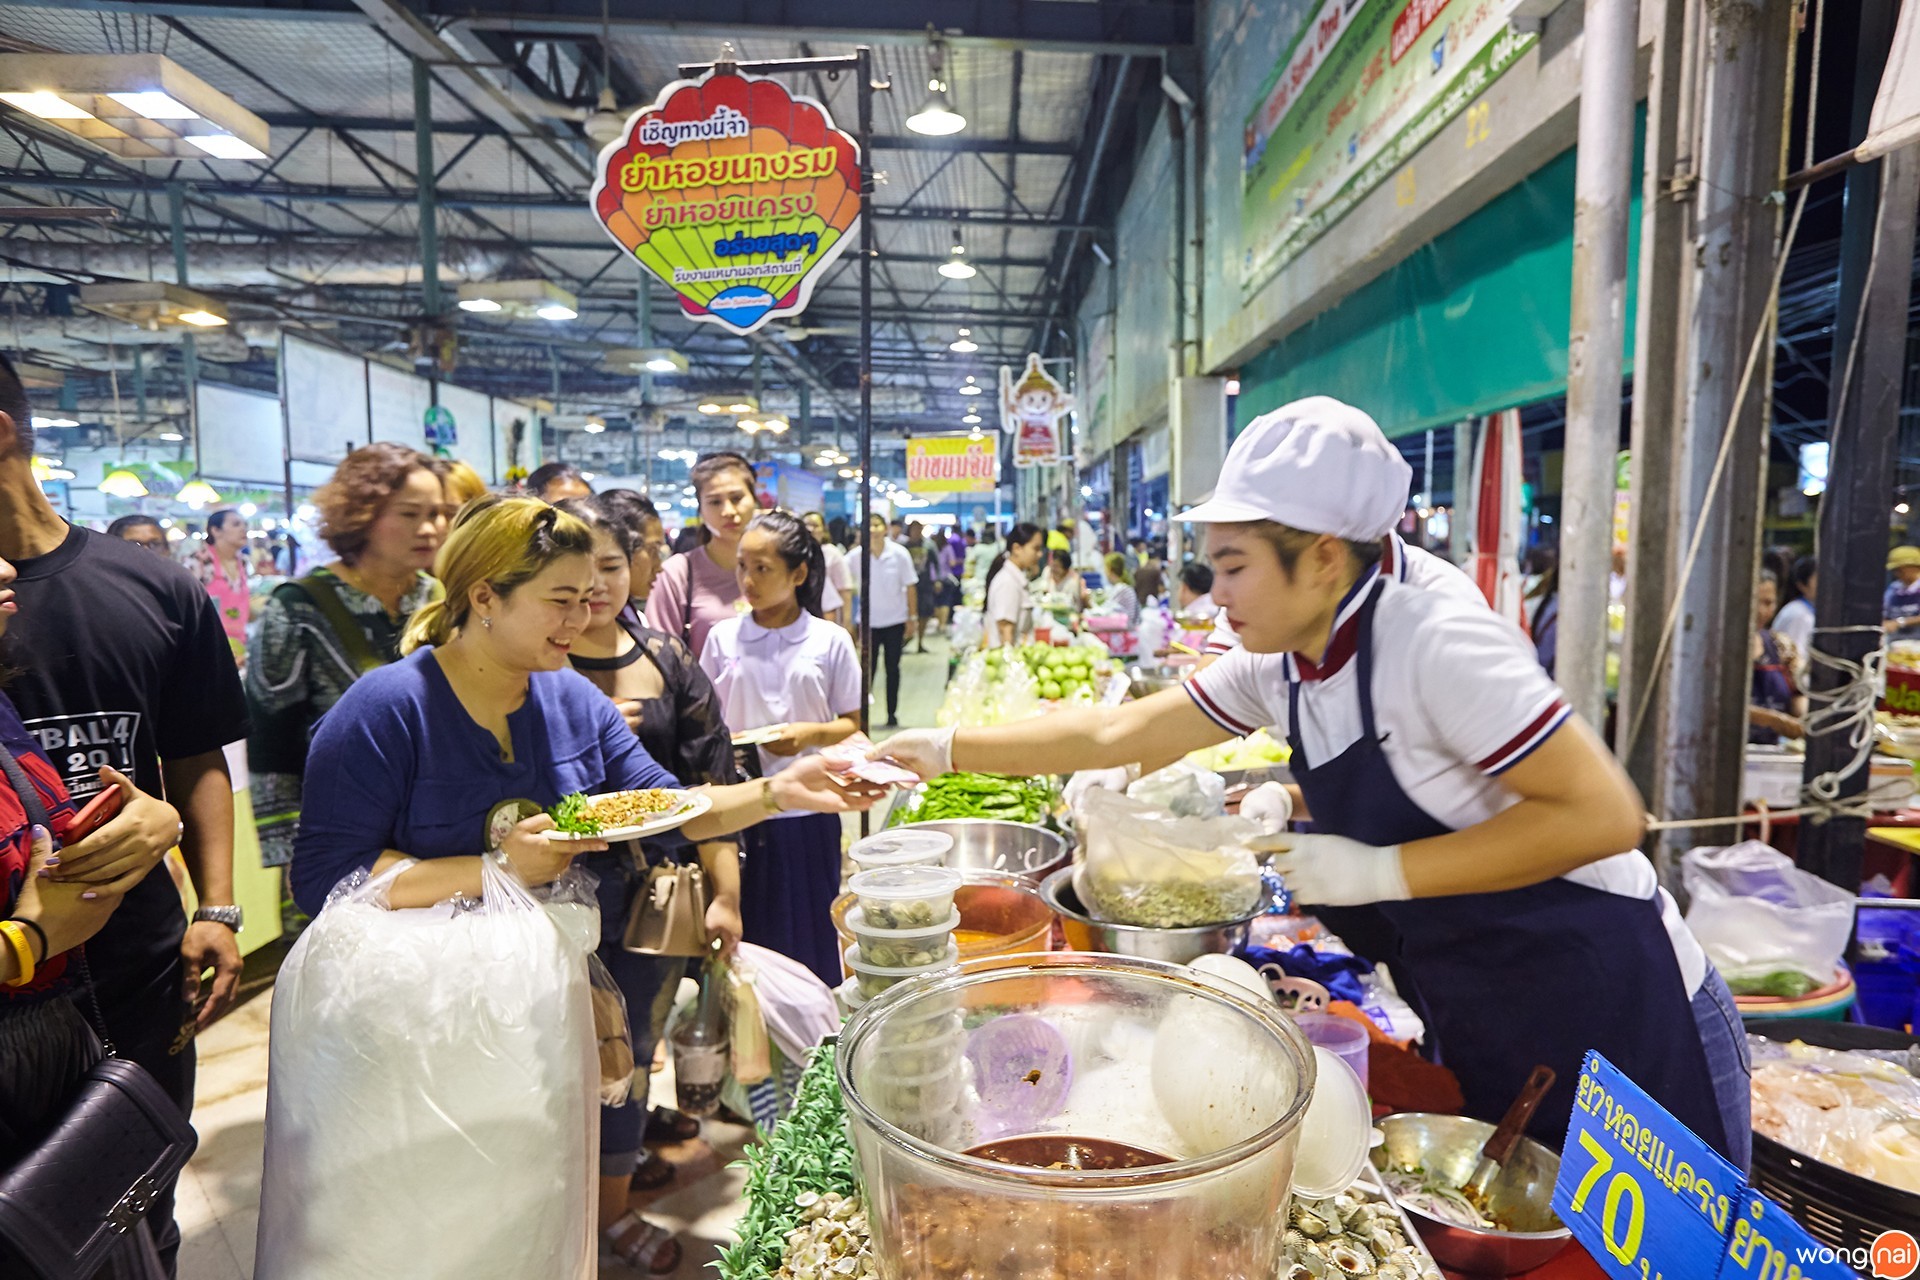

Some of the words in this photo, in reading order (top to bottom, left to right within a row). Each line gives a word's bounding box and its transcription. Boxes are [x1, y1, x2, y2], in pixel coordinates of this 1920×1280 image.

[641, 108, 747, 143] เชิญทางนี้จ้า
[623, 149, 835, 190] ยำหอยนางรม
[645, 194, 814, 226] ยำหอยแครง
[715, 231, 818, 259] อร่อยสุดๆ
[1577, 1058, 1729, 1234] ยำหอยแครง
[1570, 1127, 1645, 1266] 70
